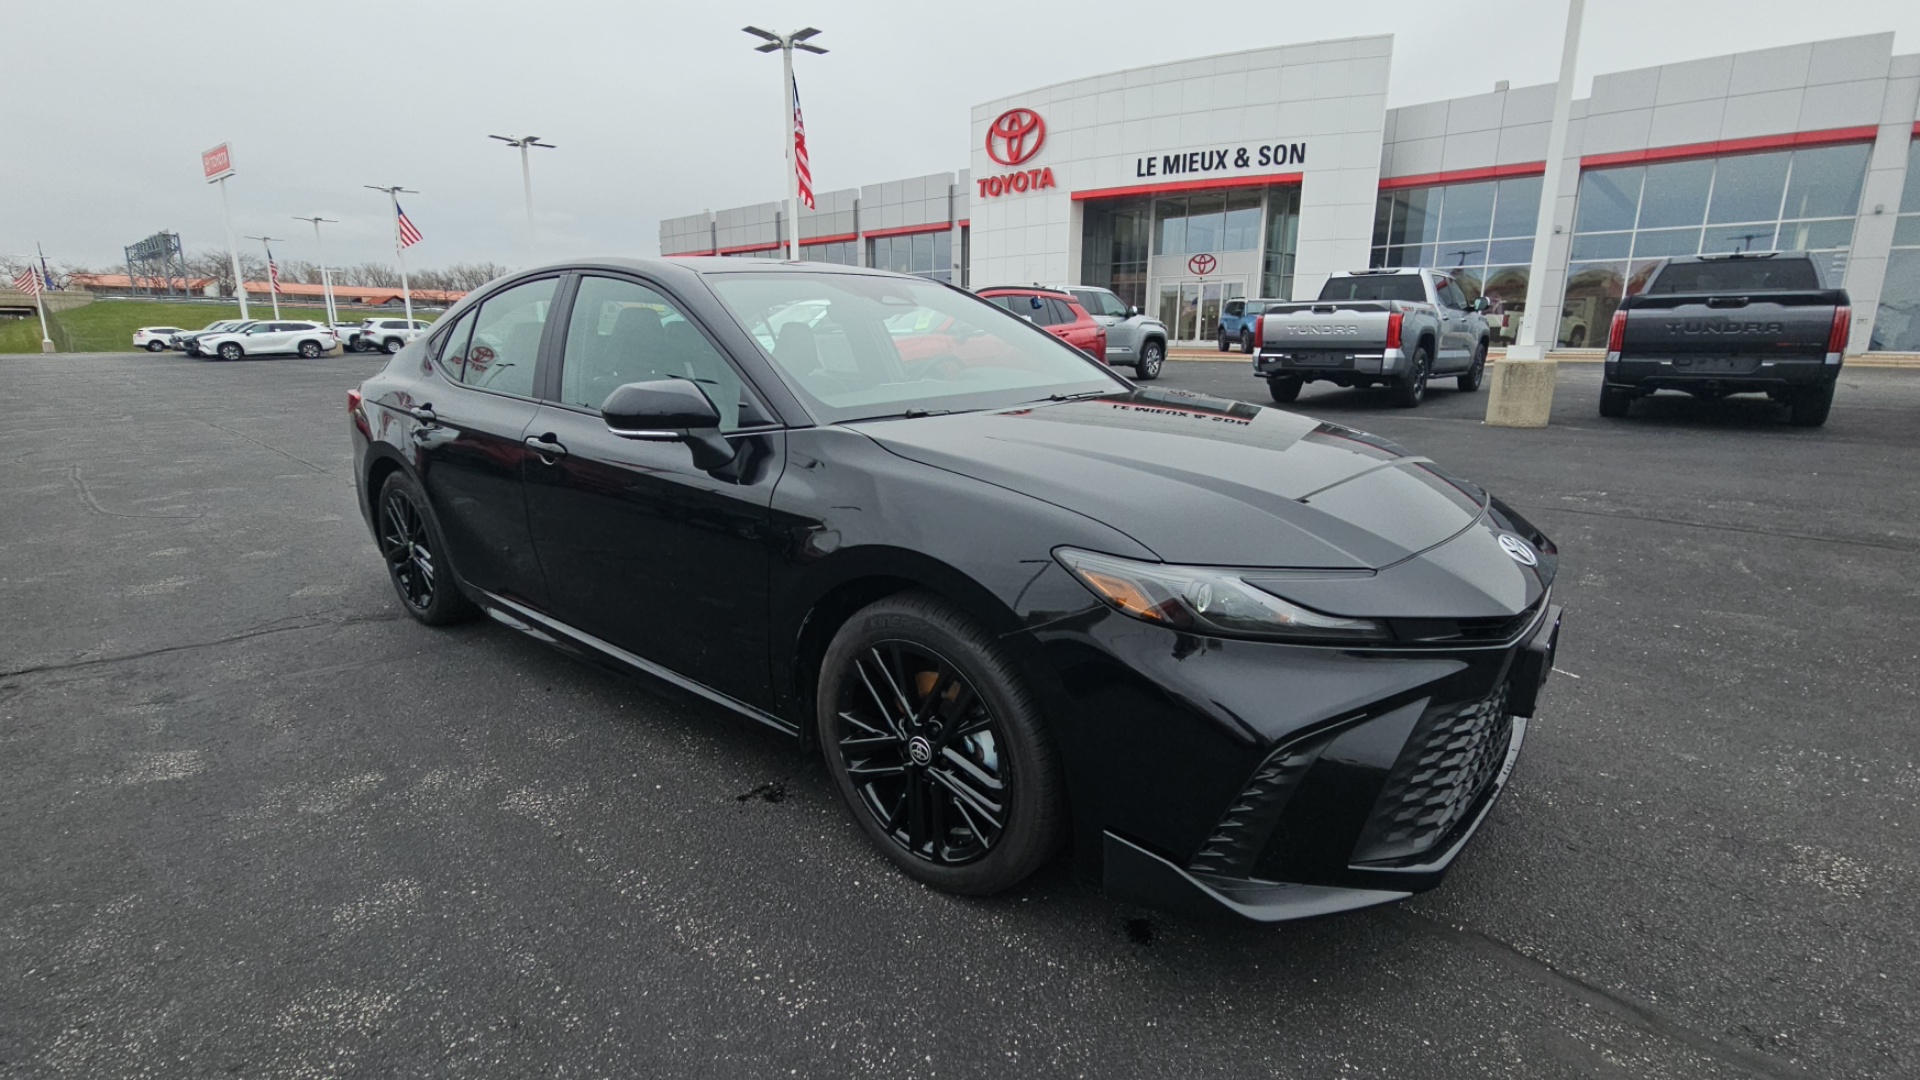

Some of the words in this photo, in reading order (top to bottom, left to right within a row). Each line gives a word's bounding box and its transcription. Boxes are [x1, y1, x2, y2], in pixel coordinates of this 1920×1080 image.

[1136, 157, 1157, 178] LE
[1162, 149, 1229, 175] MIEUX
[1233, 147, 1251, 168] &
[1257, 142, 1306, 167] SON
[977, 167, 1056, 198] TOYOTA
[1286, 325, 1359, 335] TUNDRA
[1665, 321, 1784, 335] TUNDRA
